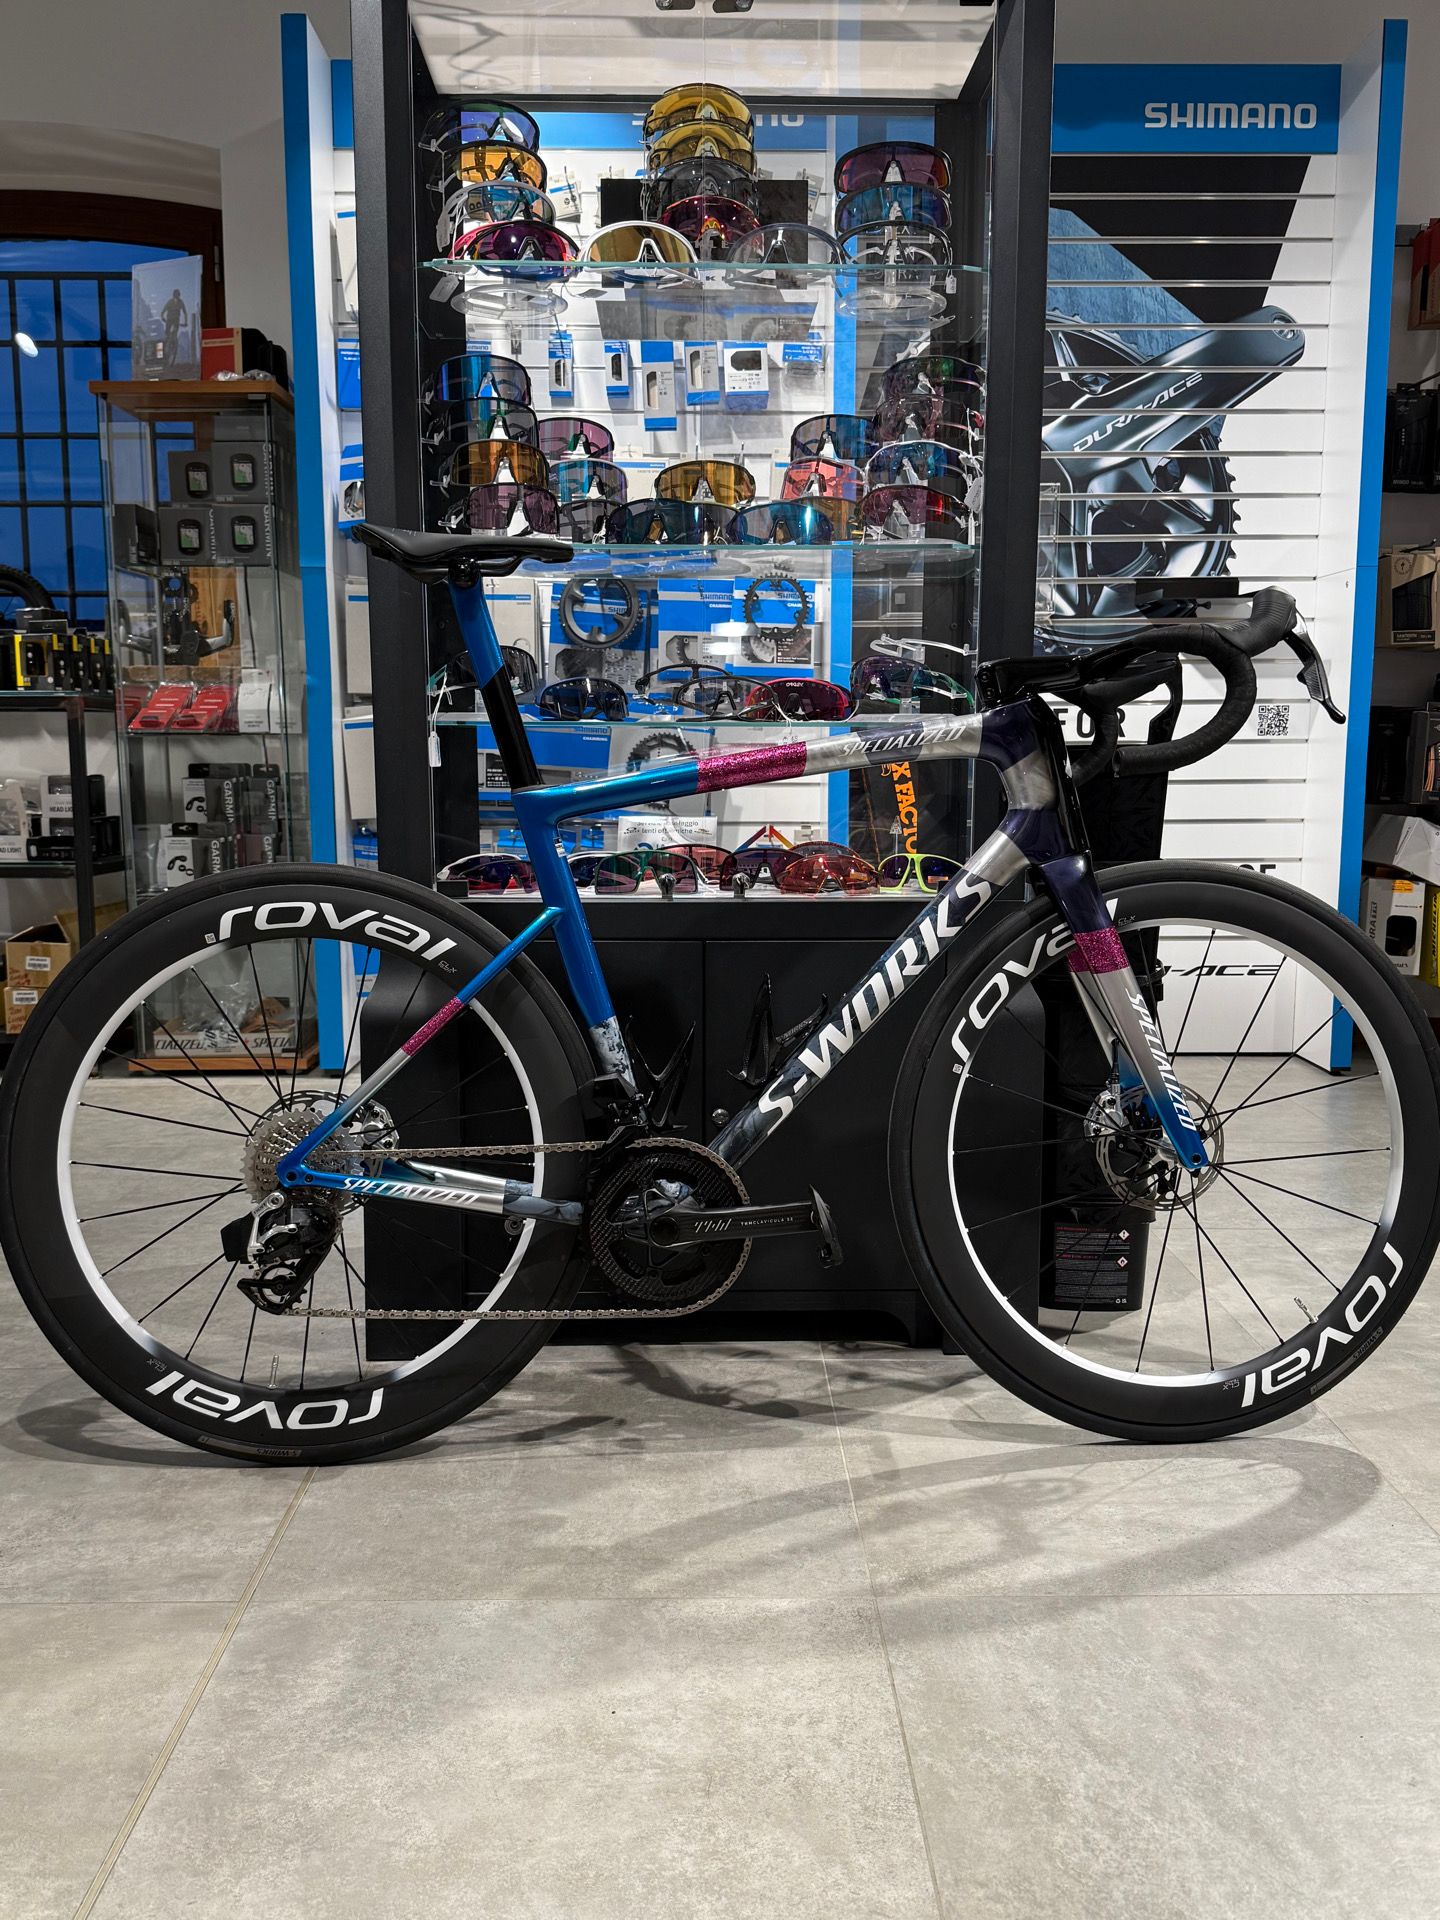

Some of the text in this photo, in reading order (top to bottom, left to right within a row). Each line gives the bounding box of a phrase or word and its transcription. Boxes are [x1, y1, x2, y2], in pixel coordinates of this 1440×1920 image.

[1144, 102, 1317, 130] SHIMANO
[1072, 372, 1204, 453] DURA-ACE
[842, 725, 966, 757] SPECIALIZED
[218, 901, 458, 961] roval
[1163, 965, 1281, 977] -ACE
[758, 876, 993, 1136] S-WORKS
[1125, 987, 1198, 1131] SPECIALIZED
[340, 1177, 481, 1205] SPECIALIZED
[1241, 1242, 1404, 1408] roval
[144, 1370, 385, 1431] roval
